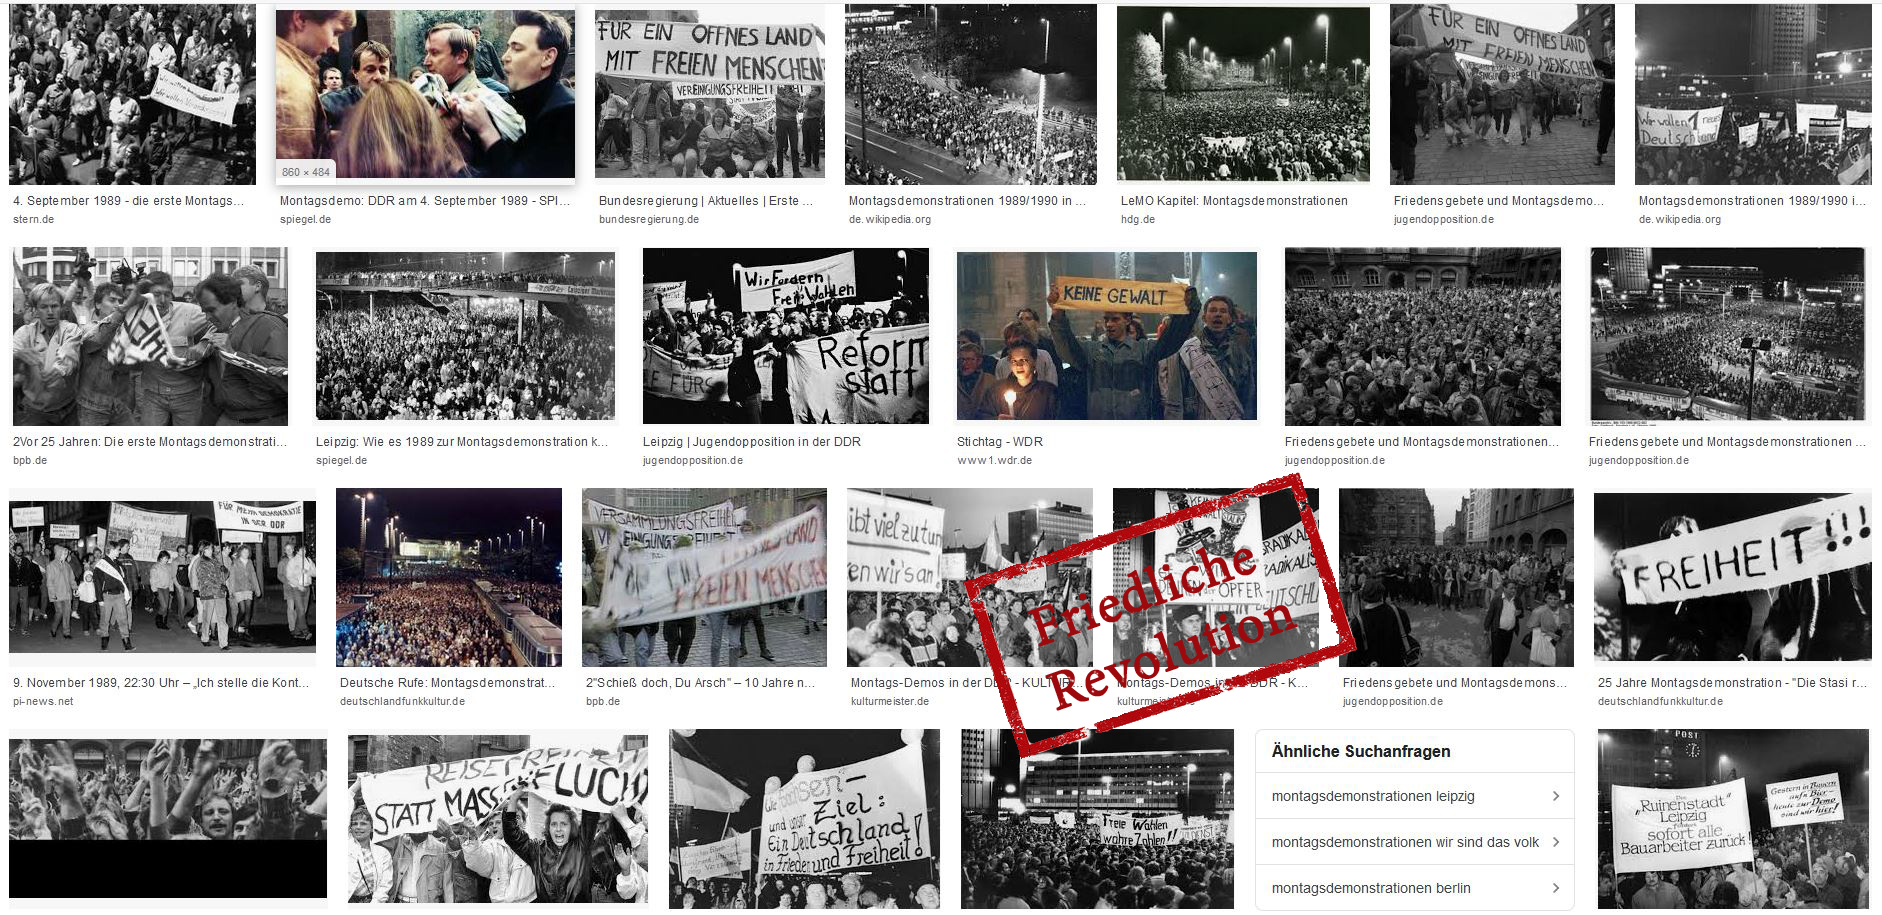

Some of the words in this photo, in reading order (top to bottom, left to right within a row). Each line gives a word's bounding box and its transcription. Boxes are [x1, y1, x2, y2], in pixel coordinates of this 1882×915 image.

[644, 23, 673, 41] EIN
[765, 26, 813, 47] LAND
[1475, 17, 1500, 38] EIN
[1560, 34, 1587, 54] LAND
[1442, 36, 1474, 52] MIT
[1483, 42, 1535, 67] FREIEN
[1537, 56, 1600, 79] MENSCHEN
[605, 50, 641, 72] MIT
[651, 50, 718, 77] FREIEN
[725, 56, 824, 81] MENSCHEN
[1658, 113, 1688, 128] wollen
[281, 167, 301, 177] 860
[311, 167, 331, 177] 484
[12, 195, 23, 206] 4.
[26, 195, 90, 208] September
[93, 195, 121, 206] 1989
[132, 195, 150, 206] die
[153, 195, 182, 206] erste
[280, 195, 364, 208] Montagsdemo:
[368, 195, 396, 206] DDR
[398, 197, 417, 206] am
[419, 195, 430, 206] 4.
[434, 195, 497, 208] September
[500, 195, 528, 206] 1989
[599, 195, 699, 208] Bundesregierung
[707, 195, 759, 206] Aktuelles
[769, 195, 799, 206] Erste
[849, 195, 994, 208] Montagsdemonstrationen
[998, 195, 1058, 206] 1989/1990
[1062, 195, 1072, 206] in
[1121, 195, 1155, 206] LeMO
[1157, 195, 1199, 208] Kapitel:
[1203, 195, 1348, 208] Montagsdemonstrationen
[1394, 195, 1484, 208] Friedensgebete
[1487, 195, 1509, 206] und
[12, 214, 55, 224] stern.de
[279, 214, 332, 226] spiegel.de
[599, 214, 700, 226] bundesregierung.de
[848, 214, 932, 226] de.wikipedia.org
[1121, 214, 1156, 226] hdg.de
[1393, 214, 1495, 226] jugendopposition.de
[744, 271, 770, 287] Wir
[1063, 284, 1103, 302] KEINE
[1107, 287, 1168, 306] GEWALT
[844, 367, 918, 398] statt
[12, 436, 39, 447] 2Vor
[40, 436, 56, 447] 25
[58, 436, 101, 447] Jahren:
[104, 436, 124, 447] Die
[127, 436, 156, 447] erste
[316, 436, 359, 449] Leipzig:
[362, 436, 384, 447] Wie
[388, 438, 402, 447] es
[405, 436, 434, 447] 1989
[436, 438, 455, 447] zur
[457, 436, 588, 449] Montagsdemonstration
[643, 436, 683, 449] Leipzig
[692, 436, 795, 449] Jugendopposition
[798, 436, 809, 447] in
[812, 436, 831, 447] der
[834, 436, 862, 447] DDR
[956, 436, 1003, 449] Stichtag
[1012, 436, 1044, 447] WDR
[13, 455, 48, 467] bpb.de
[957, 455, 1033, 465] www1.wdr.de
[270, 520, 286, 529] DDR
[873, 511, 900, 540] viel
[901, 522, 919, 542] zu
[920, 518, 943, 548] tun
[1218, 581, 1264, 600] OPFER
[13, 677, 23, 688] 9.
[27, 677, 86, 688] November
[88, 677, 120, 690] 1989,
[123, 677, 155, 688] 22:30
[159, 677, 180, 688] Uhr
[193, 677, 214, 690] „Ich
[217, 677, 248, 688] stelle
[251, 677, 270, 688] die
[340, 677, 394, 688] Deutsche
[398, 677, 428, 688] Rufe:
[585, 677, 637, 688] 2"Schieß
[641, 677, 672, 690] doch,
[675, 677, 691, 688] Du
[694, 677, 732, 688] Arsch"
[744, 677, 759, 688] 10
[761, 677, 794, 688] Jahre
[851, 677, 945, 690] Montags-Demos
[949, 677, 959, 688] in
[962, 677, 982, 688] der
[1597, 677, 1613, 688] 25
[1615, 677, 1647, 688] Jahre
[1651, 677, 1781, 690] Montagsdemonstration
[1791, 677, 1816, 688] "Die
[1819, 677, 1848, 688] Stasi
[13, 696, 74, 708] pi-news.net
[339, 696, 466, 706] deutschlandfunkkultur.de
[851, 696, 930, 706] kulturmeister.de
[1675, 729, 1698, 739] POST
[1271, 741, 1341, 758] Ähnliche
[1344, 744, 1451, 761] Suchanfragen
[1271, 790, 1432, 804] montagsdemonstrationen
[1436, 790, 1475, 804] leipzig
[1770, 785, 1801, 796] Gestern
[1811, 797, 1836, 807] Demo
[373, 798, 437, 836] STATT
[769, 816, 787, 833] und
[813, 792, 872, 825] Ziel
[1659, 811, 1707, 825] Leipzig
[1132, 817, 1169, 831] Wahlen
[768, 835, 789, 852] Ein
[791, 812, 910, 852] Deutschland
[1103, 830, 1134, 846] wahre
[1647, 827, 1694, 842] sofort
[1698, 824, 1723, 838] alle
[1271, 836, 1432, 850] montagsdemonstrationen
[1436, 836, 1454, 848] wir
[1457, 836, 1483, 848] sind
[1487, 836, 1511, 848] das
[1513, 836, 1540, 848] volk
[1620, 839, 1704, 855] Bauarbeiter
[763, 857, 775, 872] in
[812, 846, 841, 873] und
[1271, 882, 1432, 896] montagsdemonstrationen
[1436, 882, 1471, 894] berlin
